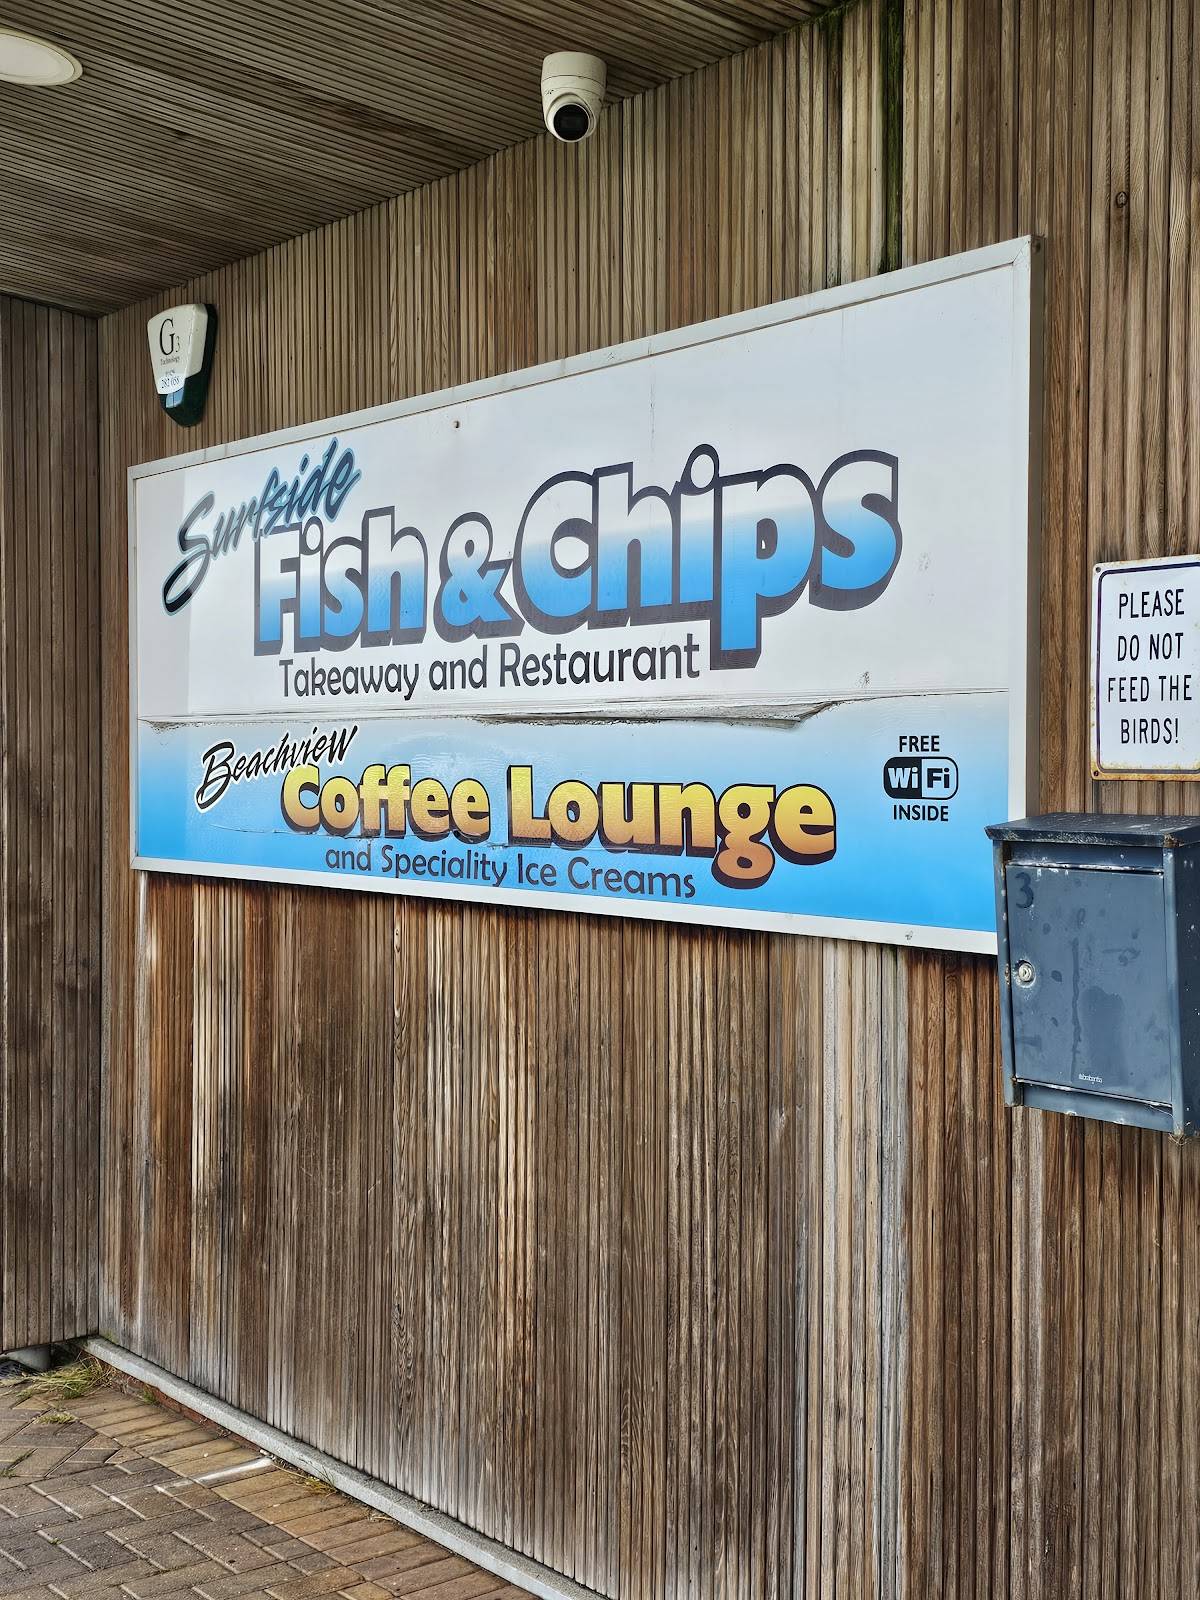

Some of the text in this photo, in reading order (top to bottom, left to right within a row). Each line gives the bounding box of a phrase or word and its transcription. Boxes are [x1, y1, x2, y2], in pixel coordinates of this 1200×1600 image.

[162, 436, 362, 617] Surfside
[253, 443, 903, 671] Fish & Chips
[1118, 588, 1185, 620] PLEASE
[1117, 632, 1184, 662] DO NOT
[279, 633, 701, 700] Takeaway and Restaurant
[1107, 674, 1192, 702] FEED THE
[899, 735, 940, 752] FREE
[1120, 717, 1179, 744] BIRDS!
[195, 724, 359, 811] Beachview
[281, 763, 837, 889] Coffee Lounge
[893, 804, 949, 821] INSIDE
[325, 842, 696, 899] and Speciality Ice Creams
[1015, 871, 1034, 909] 3
